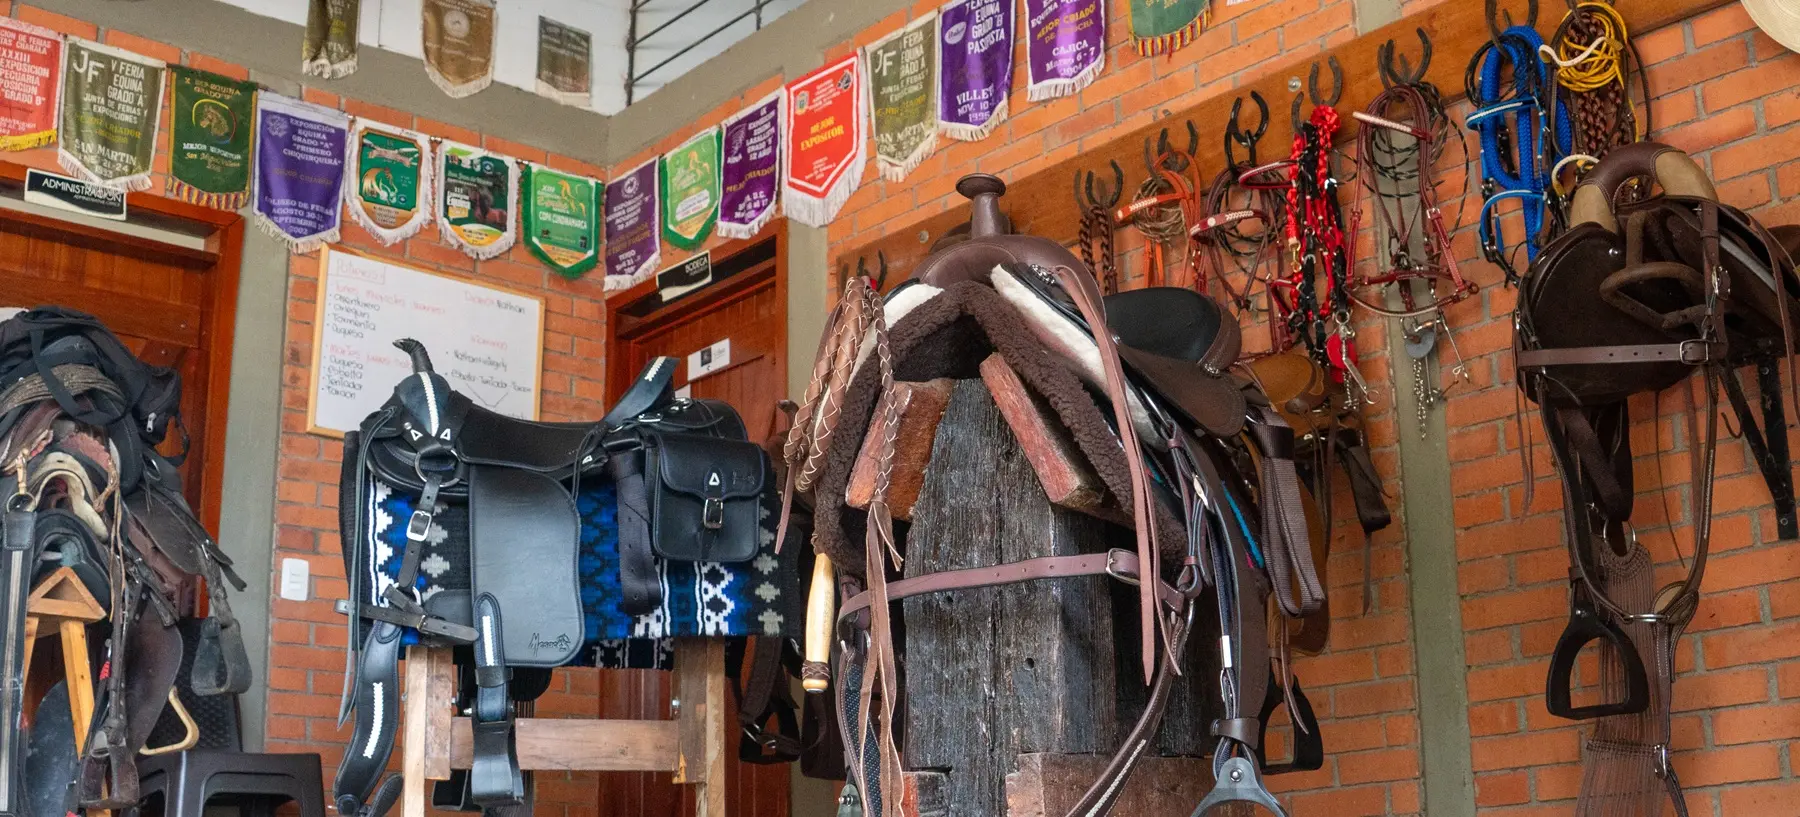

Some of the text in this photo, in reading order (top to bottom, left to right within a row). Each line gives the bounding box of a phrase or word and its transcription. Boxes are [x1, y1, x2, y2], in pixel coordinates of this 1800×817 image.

[1052, 40, 1089, 56] CAJICA
[119, 62, 145, 80] FERIA
[113, 74, 143, 93] EQUINA
[83, 93, 105, 105] JUNTA
[107, 100, 116, 109] DE
[108, 85, 135, 105] GRADO
[810, 116, 835, 134] MEJOR
[291, 135, 318, 147] GRADO
[297, 129, 327, 140] EQUINA
[800, 125, 845, 151] EXPOSITOR
[97, 143, 137, 166] MARTIN
[685, 256, 708, 274] BODEGA
